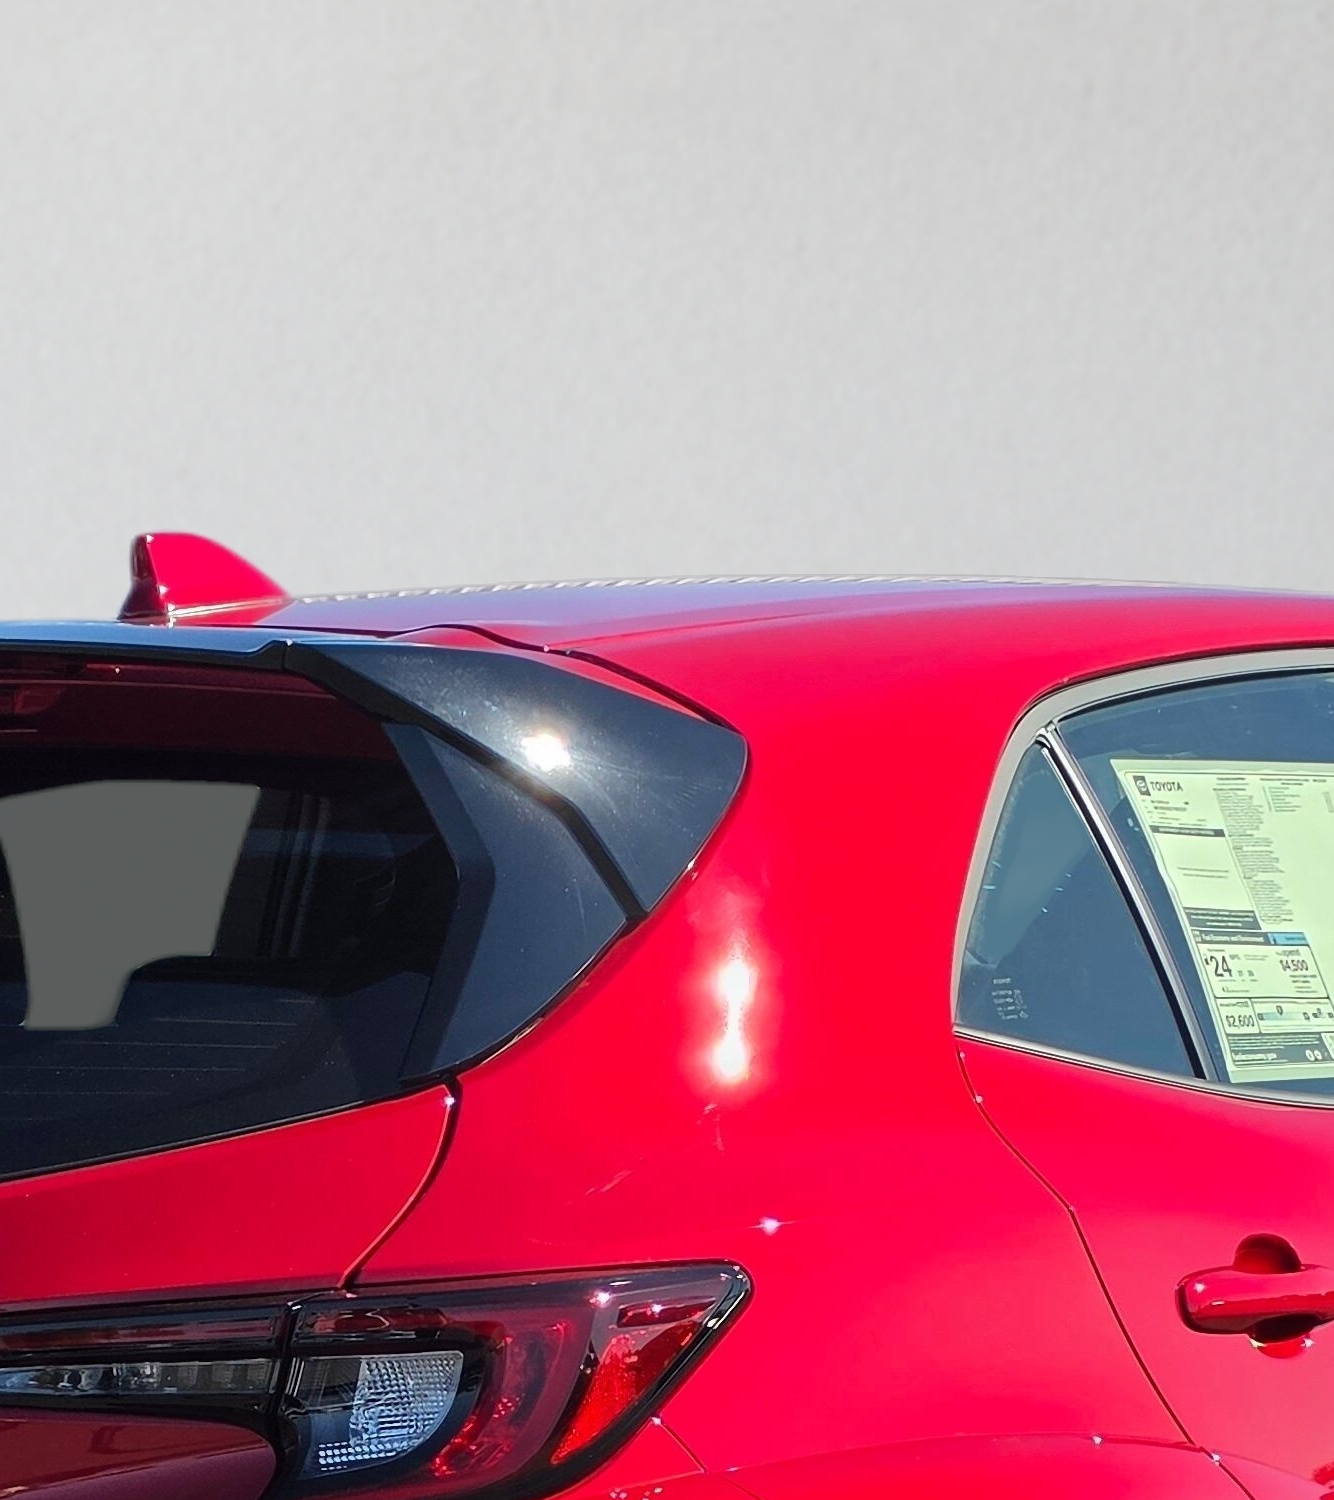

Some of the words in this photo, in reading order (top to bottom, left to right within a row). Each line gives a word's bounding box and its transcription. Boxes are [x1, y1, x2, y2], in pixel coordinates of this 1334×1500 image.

[1149, 781, 1183, 792] TOYOTA
[1210, 955, 1232, 977] 24
[1279, 959, 1309, 972] $4,500
[1225, 1014, 1255, 1028] $2,600
